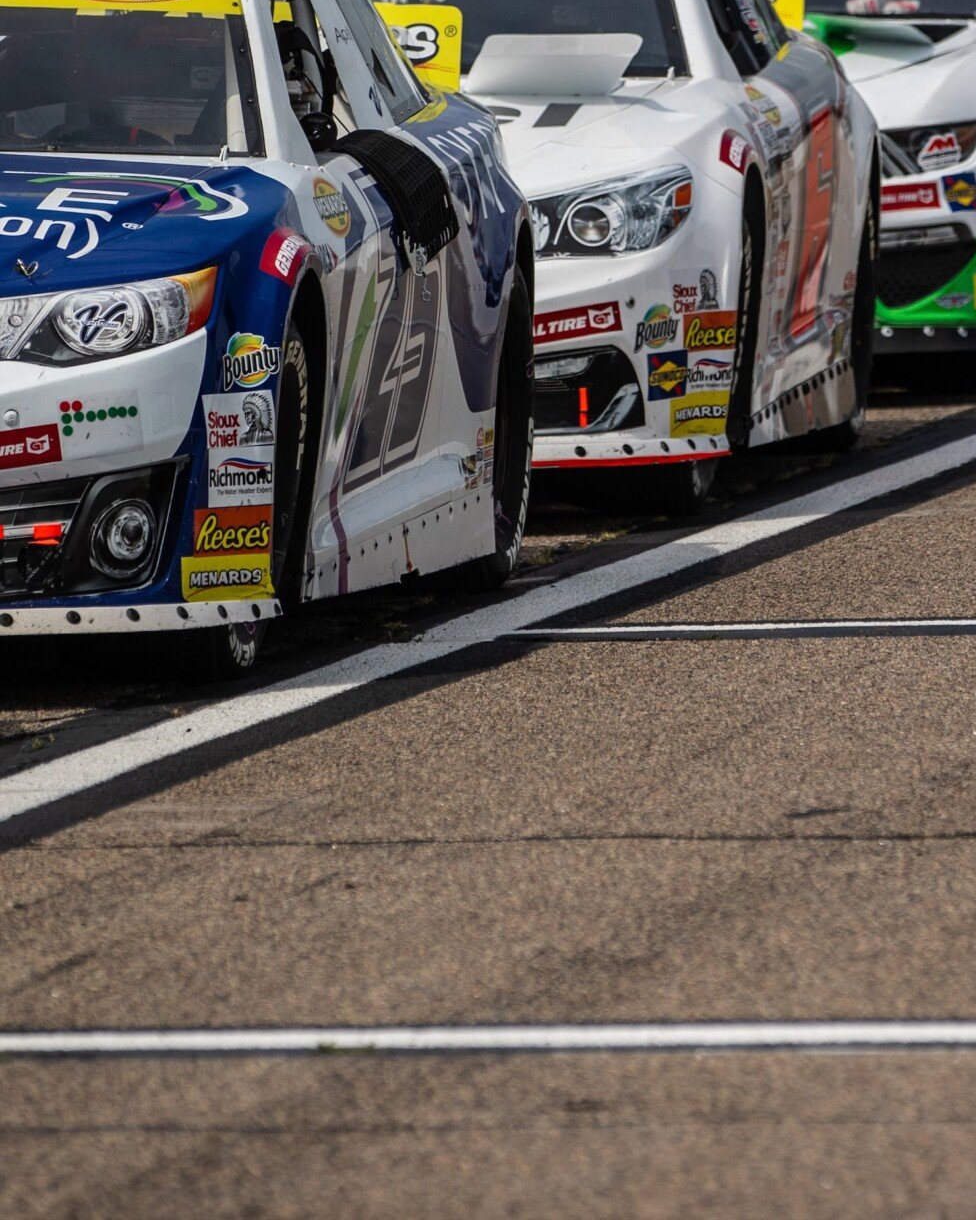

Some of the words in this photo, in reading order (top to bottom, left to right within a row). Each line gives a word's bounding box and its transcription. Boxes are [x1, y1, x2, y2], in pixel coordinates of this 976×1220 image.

[672, 284, 697, 299] Sioux
[673, 299, 697, 314] Chief
[548, 316, 587, 334] TIRE
[634, 316, 680, 354] Bounty
[223, 346, 280, 391] Bounty
[207, 410, 241, 429] Sioux
[208, 430, 239, 448] Chief
[209, 463, 273, 488] Richmond
[239, 487, 255, 495] Heater
[195, 514, 270, 553] Reese's
[189, 568, 263, 588] MENARDS
